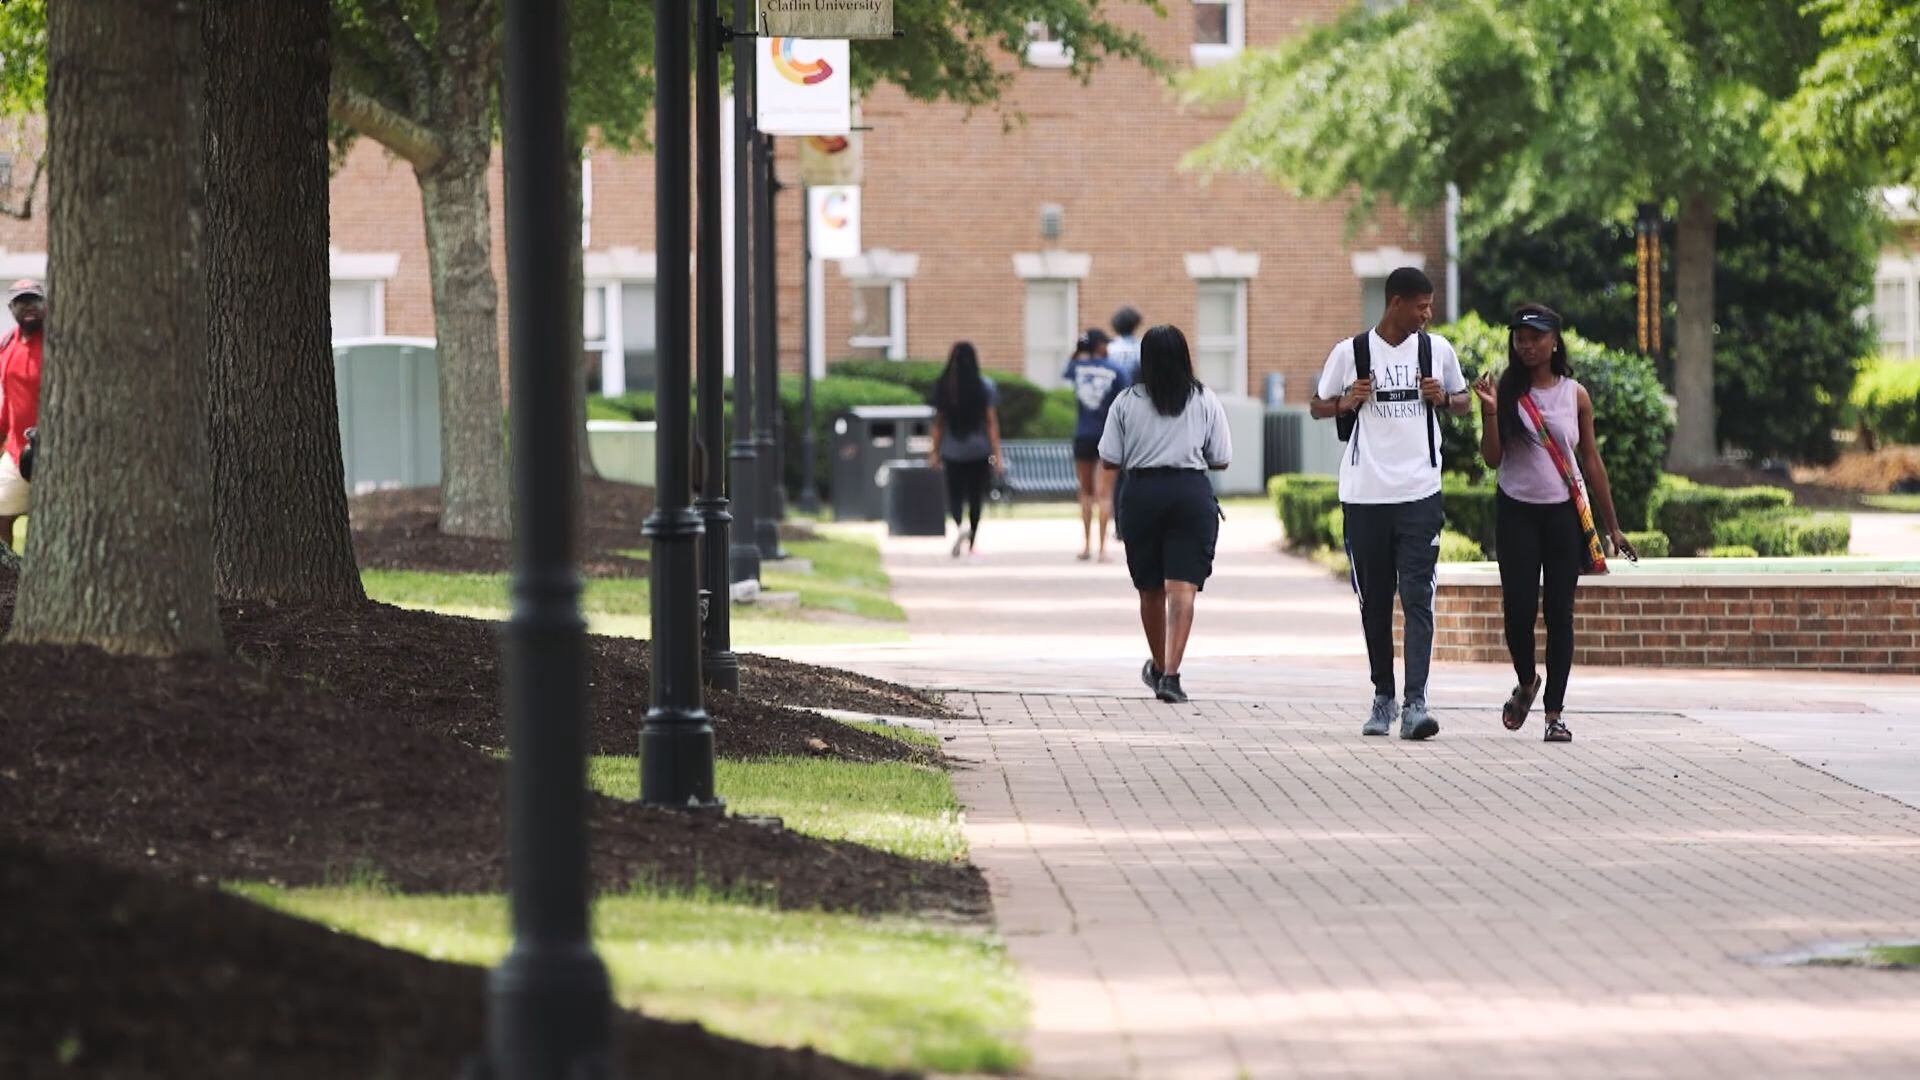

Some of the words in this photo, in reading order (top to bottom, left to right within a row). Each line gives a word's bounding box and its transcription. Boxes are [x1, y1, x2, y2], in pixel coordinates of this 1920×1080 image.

[768, 0, 810, 11] Claflin
[815, 0, 881, 14] University
[1369, 365, 1421, 390] LAFLI
[1389, 391, 1406, 401] 2017
